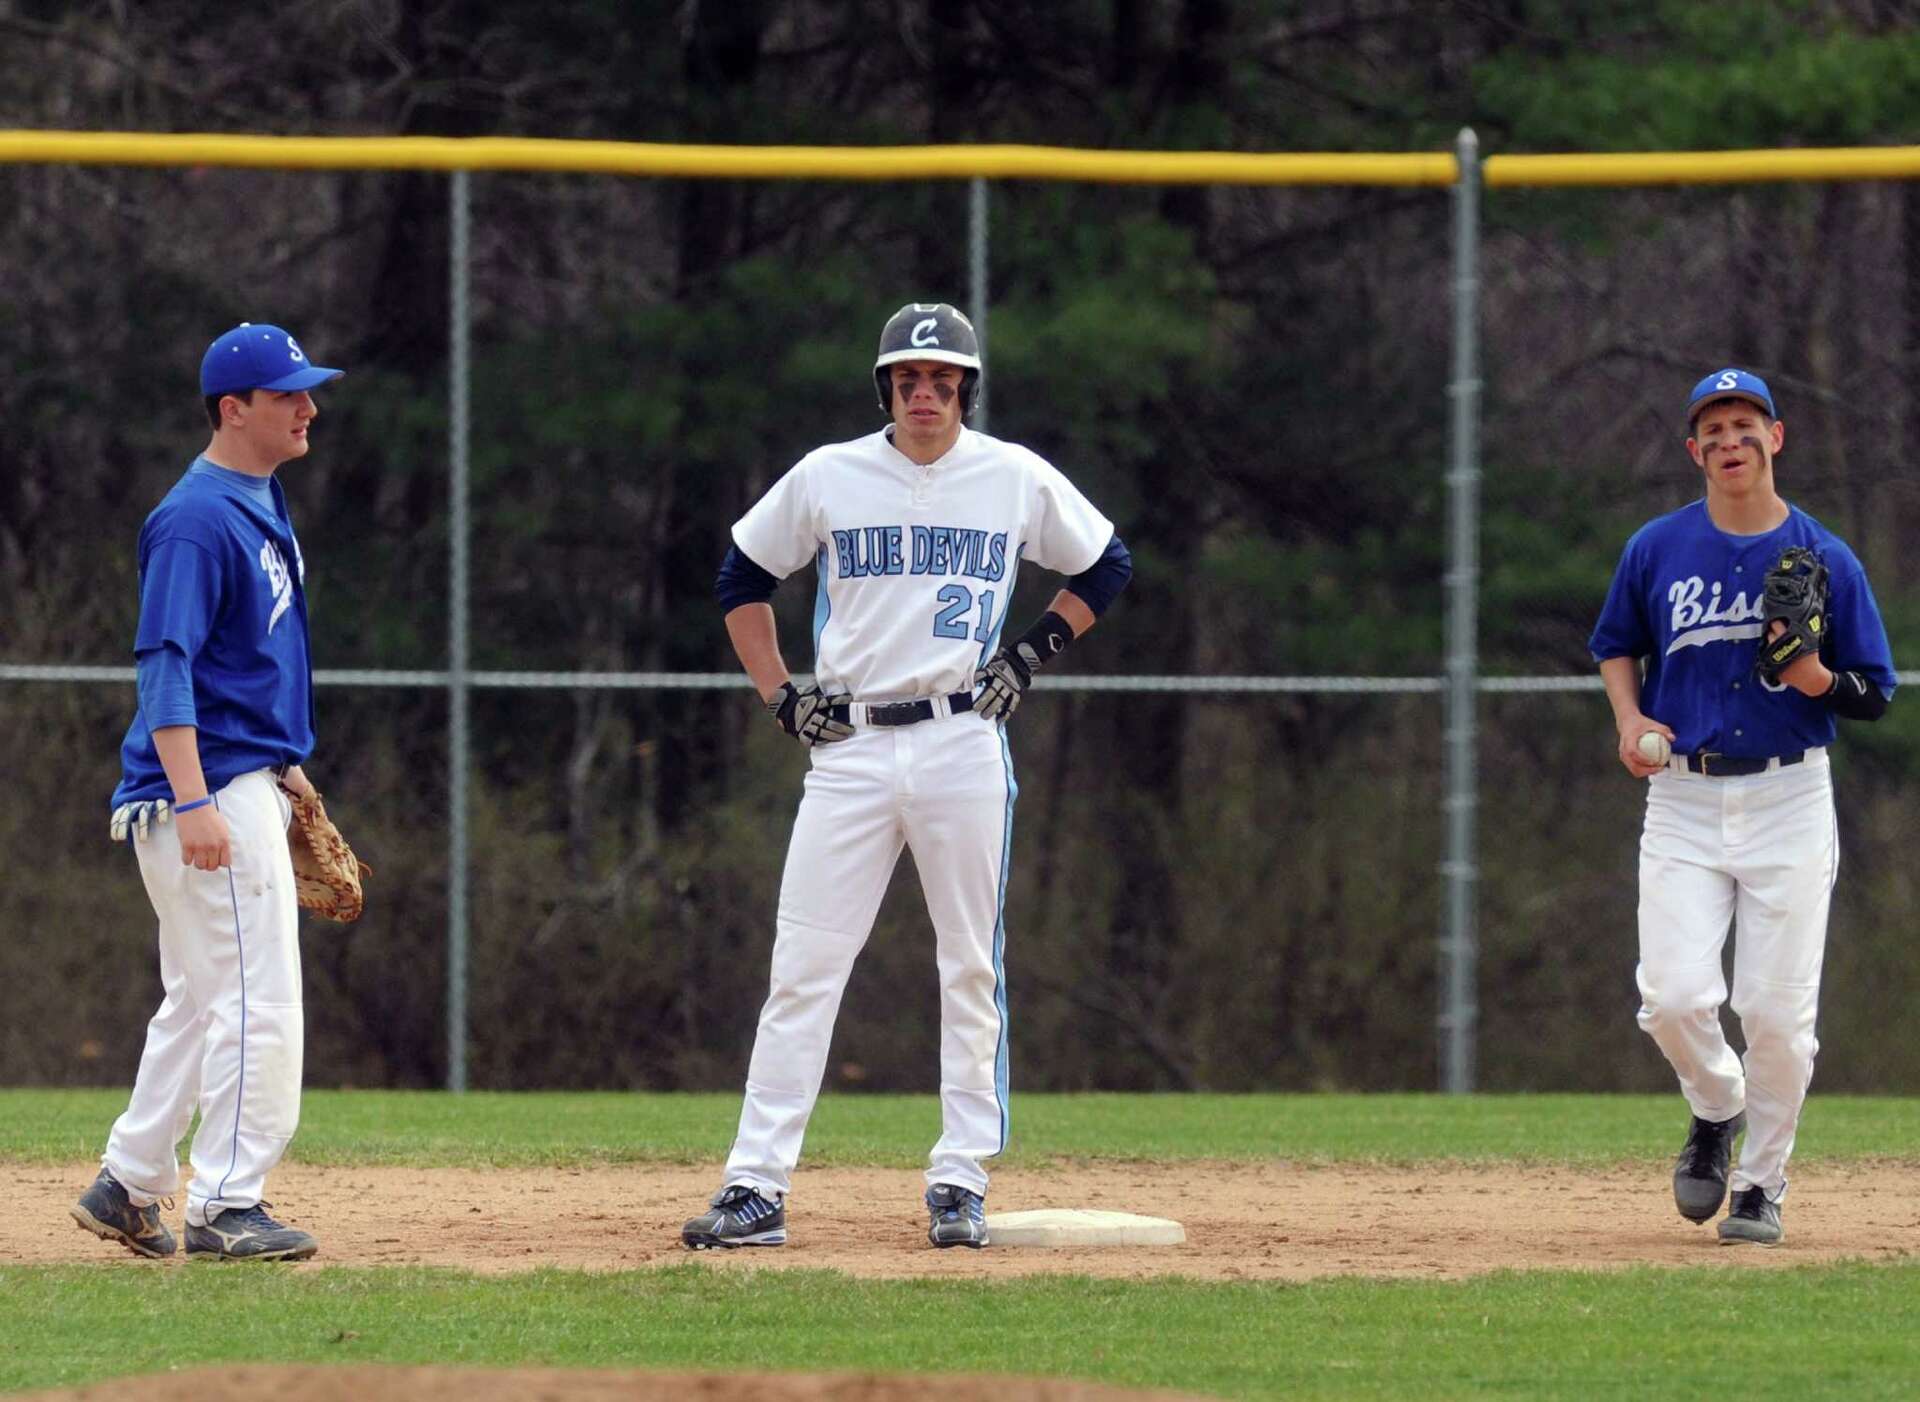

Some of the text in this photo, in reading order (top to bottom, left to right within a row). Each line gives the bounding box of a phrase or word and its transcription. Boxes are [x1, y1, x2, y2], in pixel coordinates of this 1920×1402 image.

[910, 317, 939, 348] C
[287, 336, 303, 361] S
[1716, 371, 1738, 390] S
[832, 525, 1008, 582] BLUE DEVILS
[933, 584, 994, 644] 21
